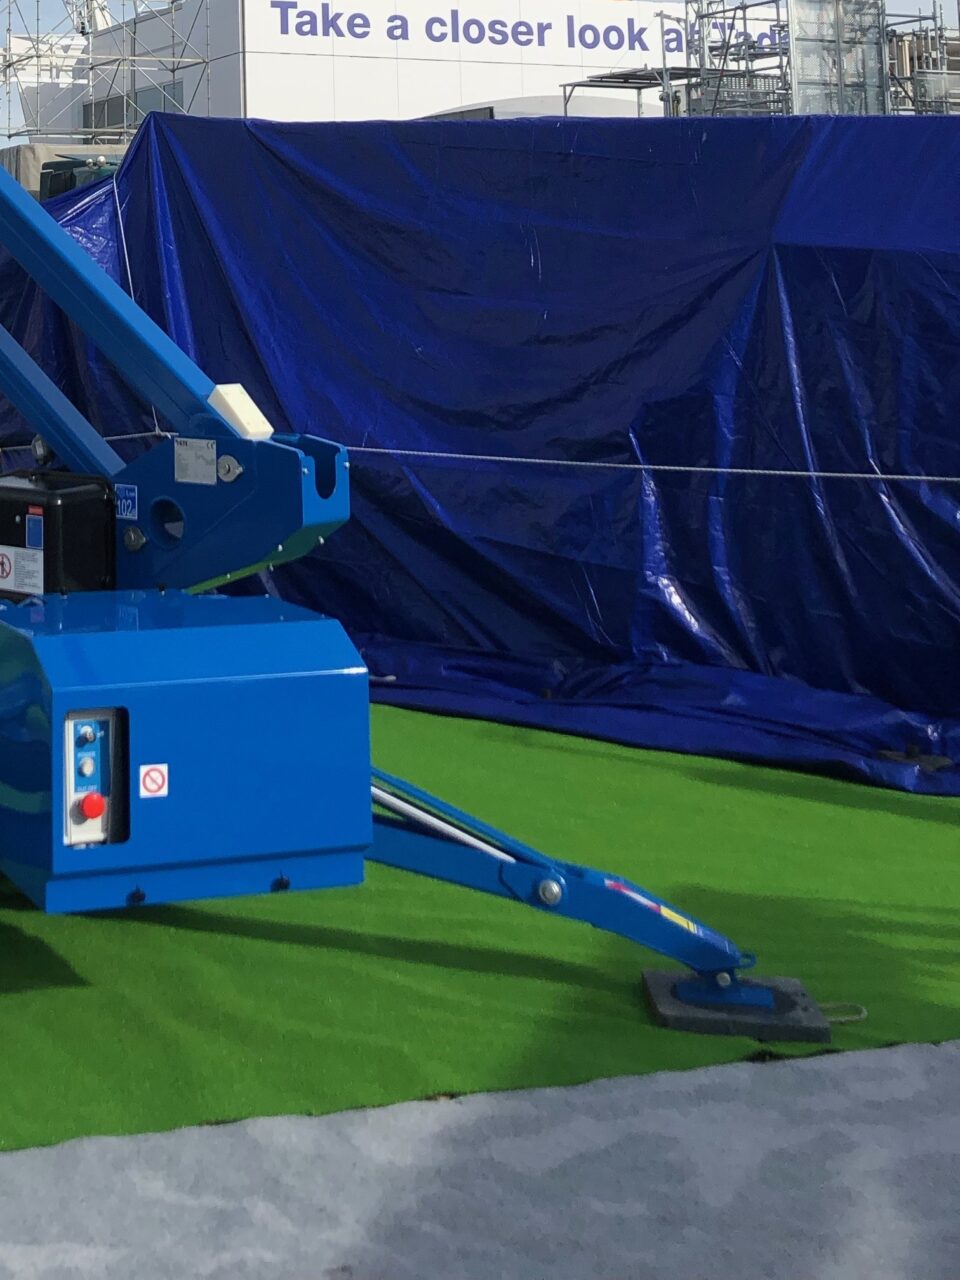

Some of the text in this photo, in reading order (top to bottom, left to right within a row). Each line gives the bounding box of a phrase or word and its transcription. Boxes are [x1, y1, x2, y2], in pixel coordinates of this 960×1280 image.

[270, 0, 371, 39] Take
[386, 13, 410, 41] a
[424, 9, 553, 47] closer
[566, 15, 649, 52] look
